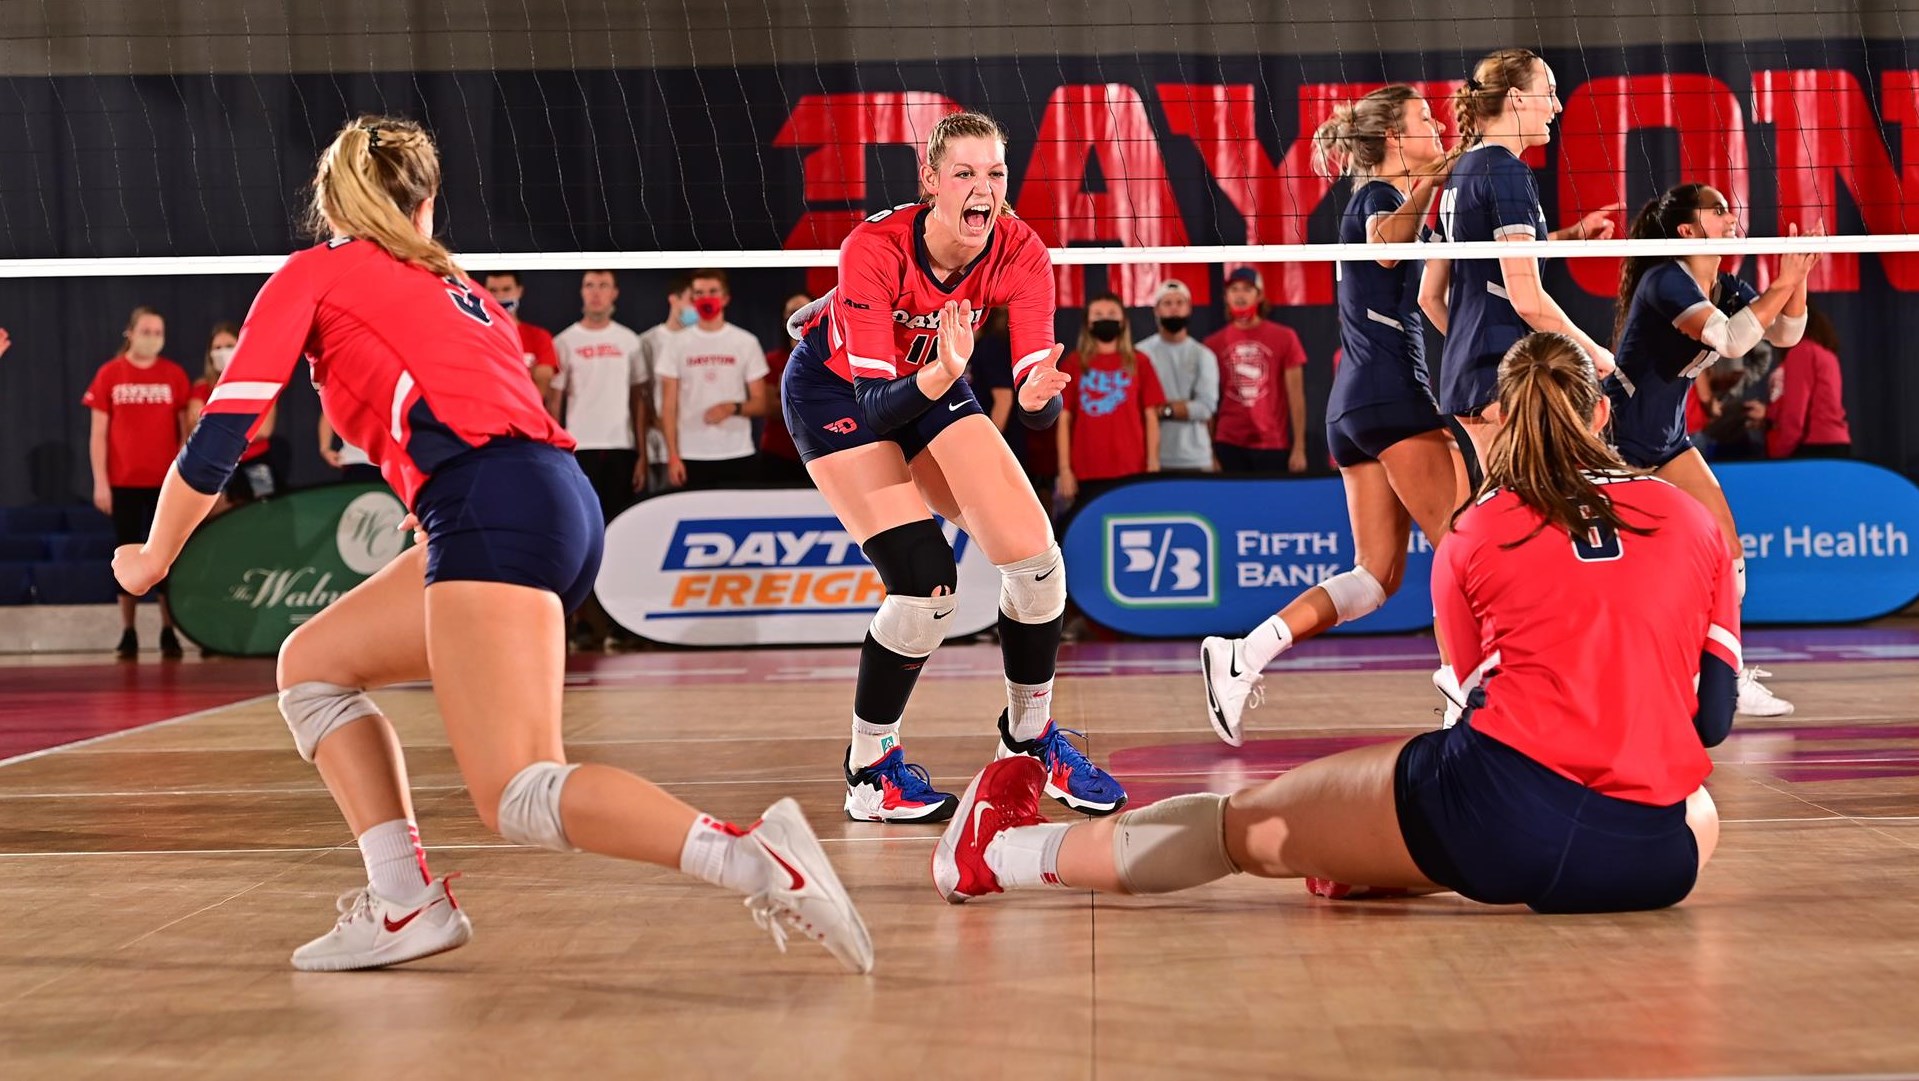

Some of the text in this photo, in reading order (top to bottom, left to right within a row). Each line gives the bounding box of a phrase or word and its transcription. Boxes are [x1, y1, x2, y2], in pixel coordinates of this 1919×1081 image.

[772, 69, 1919, 307] DAYON
[683, 530, 873, 568] DAYT
[1236, 530, 1338, 556] FIFTH
[1784, 522, 1908, 558] Health
[670, 570, 889, 608] FREIGH
